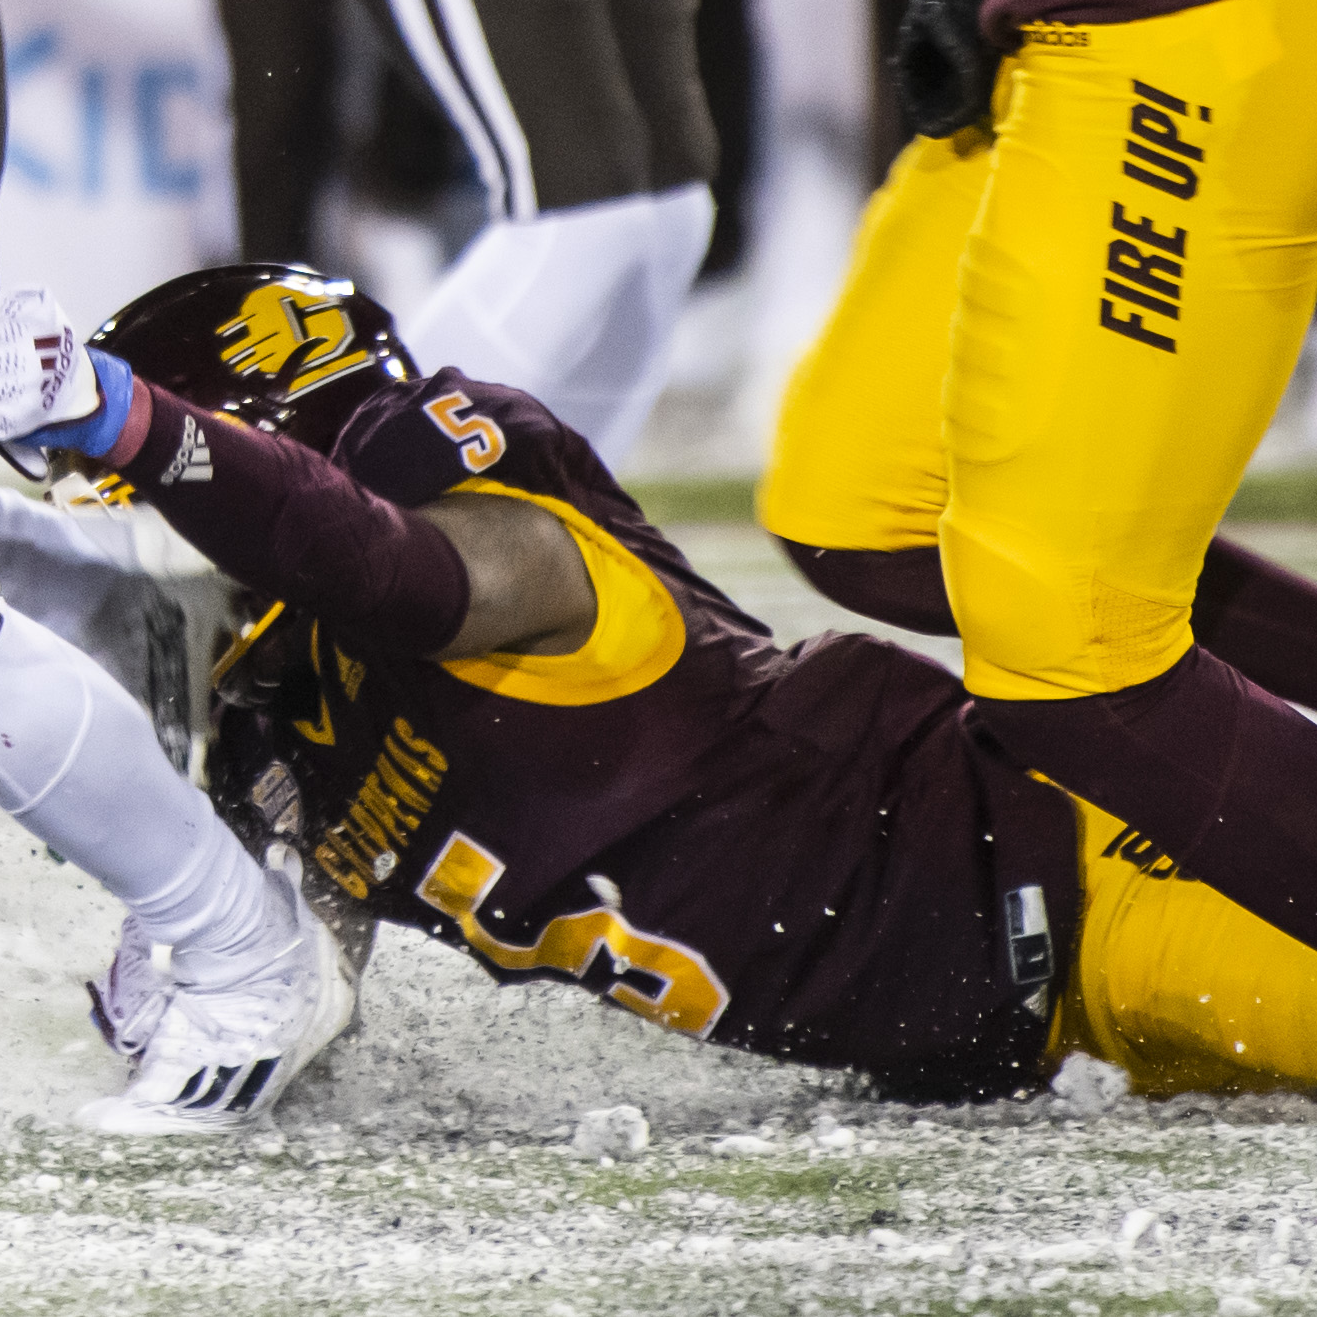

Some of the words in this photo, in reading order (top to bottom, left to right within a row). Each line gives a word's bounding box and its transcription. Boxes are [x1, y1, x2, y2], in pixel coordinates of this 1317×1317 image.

[1121, 78, 1213, 201] UP!
[1099, 200, 1188, 354] FIRE
[423, 390, 506, 473] 5
[414, 830, 731, 1040] 5
